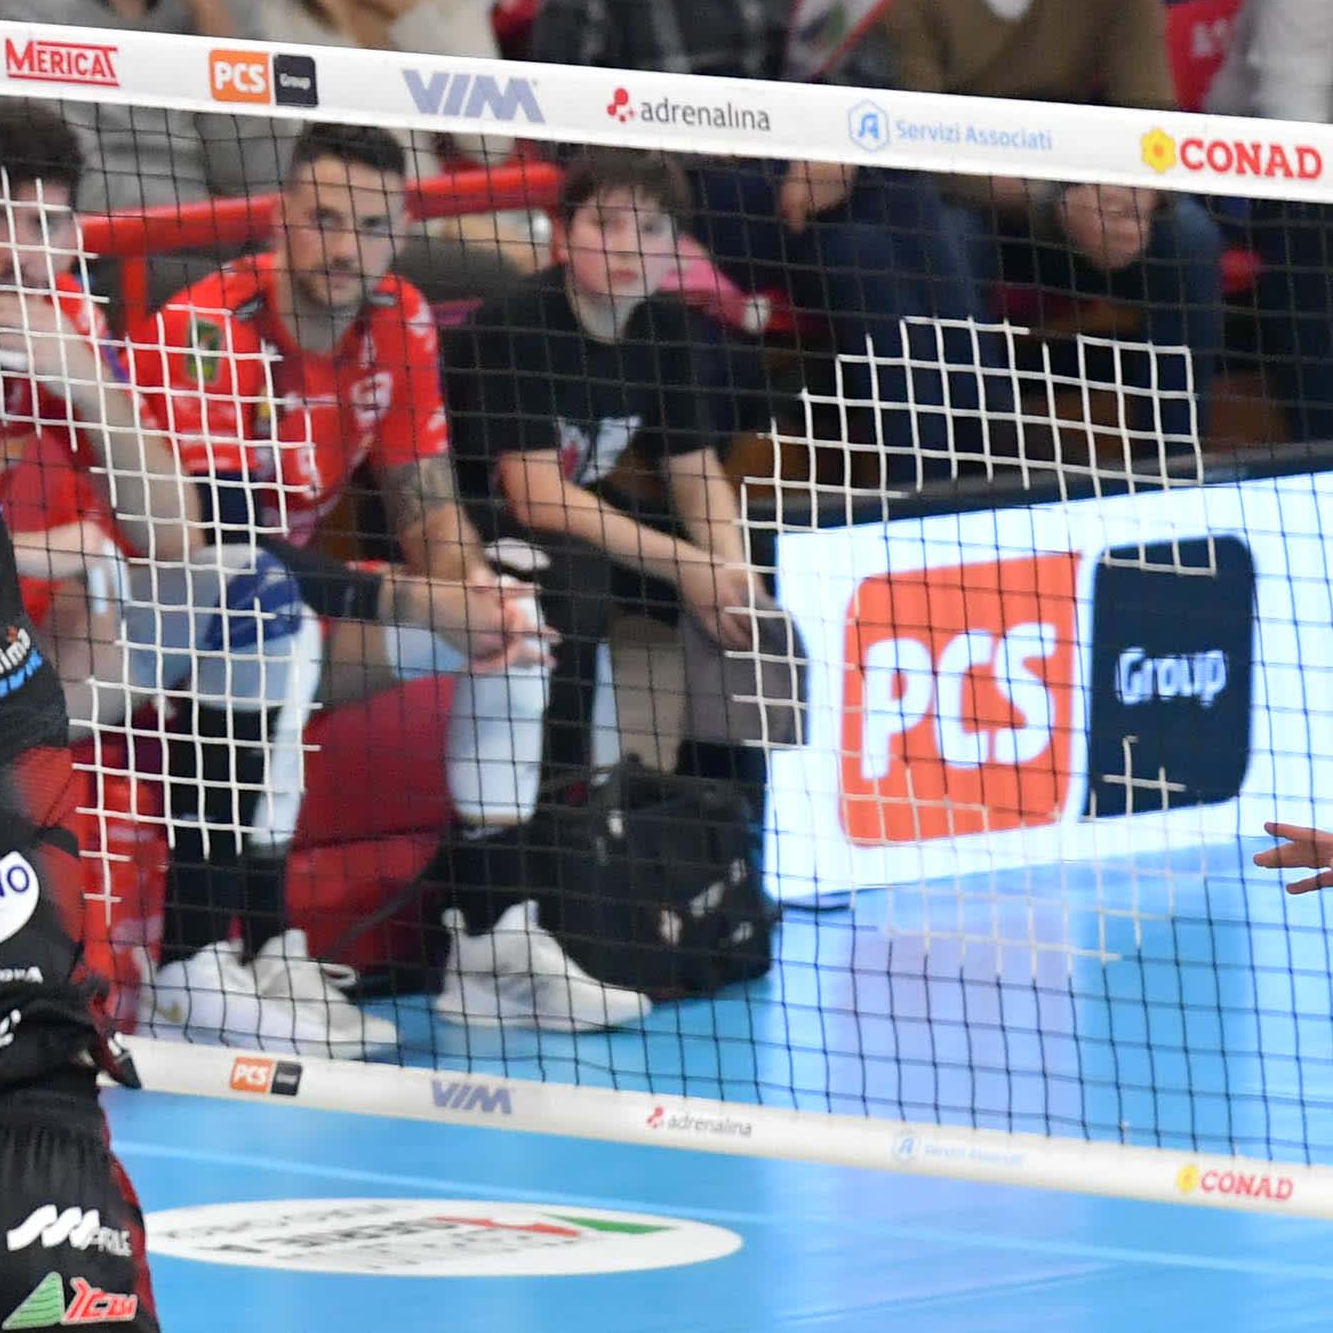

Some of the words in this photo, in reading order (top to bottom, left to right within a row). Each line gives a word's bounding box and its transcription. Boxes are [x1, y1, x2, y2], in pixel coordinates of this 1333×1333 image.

[212, 61, 266, 95] PCS
[640, 98, 772, 133] adrenalina
[895, 120, 962, 146] Servizi
[965, 125, 1054, 152] Associati
[1179, 137, 1323, 181] CONAD
[861, 621, 1058, 782] PCS
[1116, 646, 1229, 708] Group
[234, 1062, 267, 1086] PCS
[1200, 1169, 1295, 1201] CONAD
